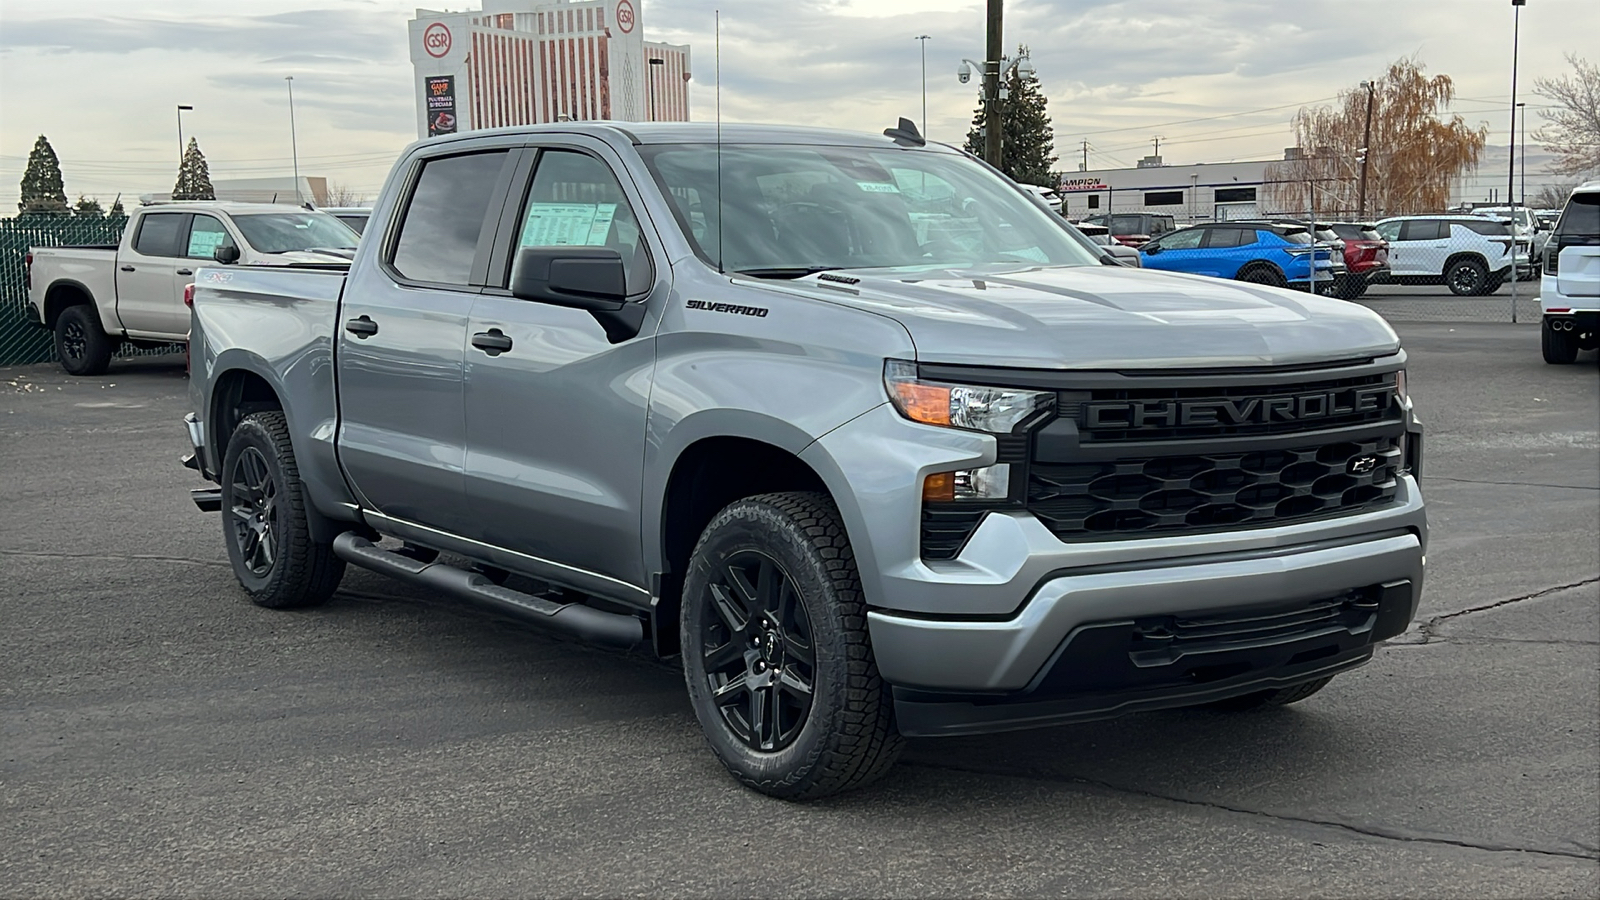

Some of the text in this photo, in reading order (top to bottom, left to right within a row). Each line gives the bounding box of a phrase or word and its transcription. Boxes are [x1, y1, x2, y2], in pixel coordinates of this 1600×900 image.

[619, 9, 634, 24] GSR
[427, 32, 448, 48] GSR
[685, 299, 769, 318] SILVERADO
